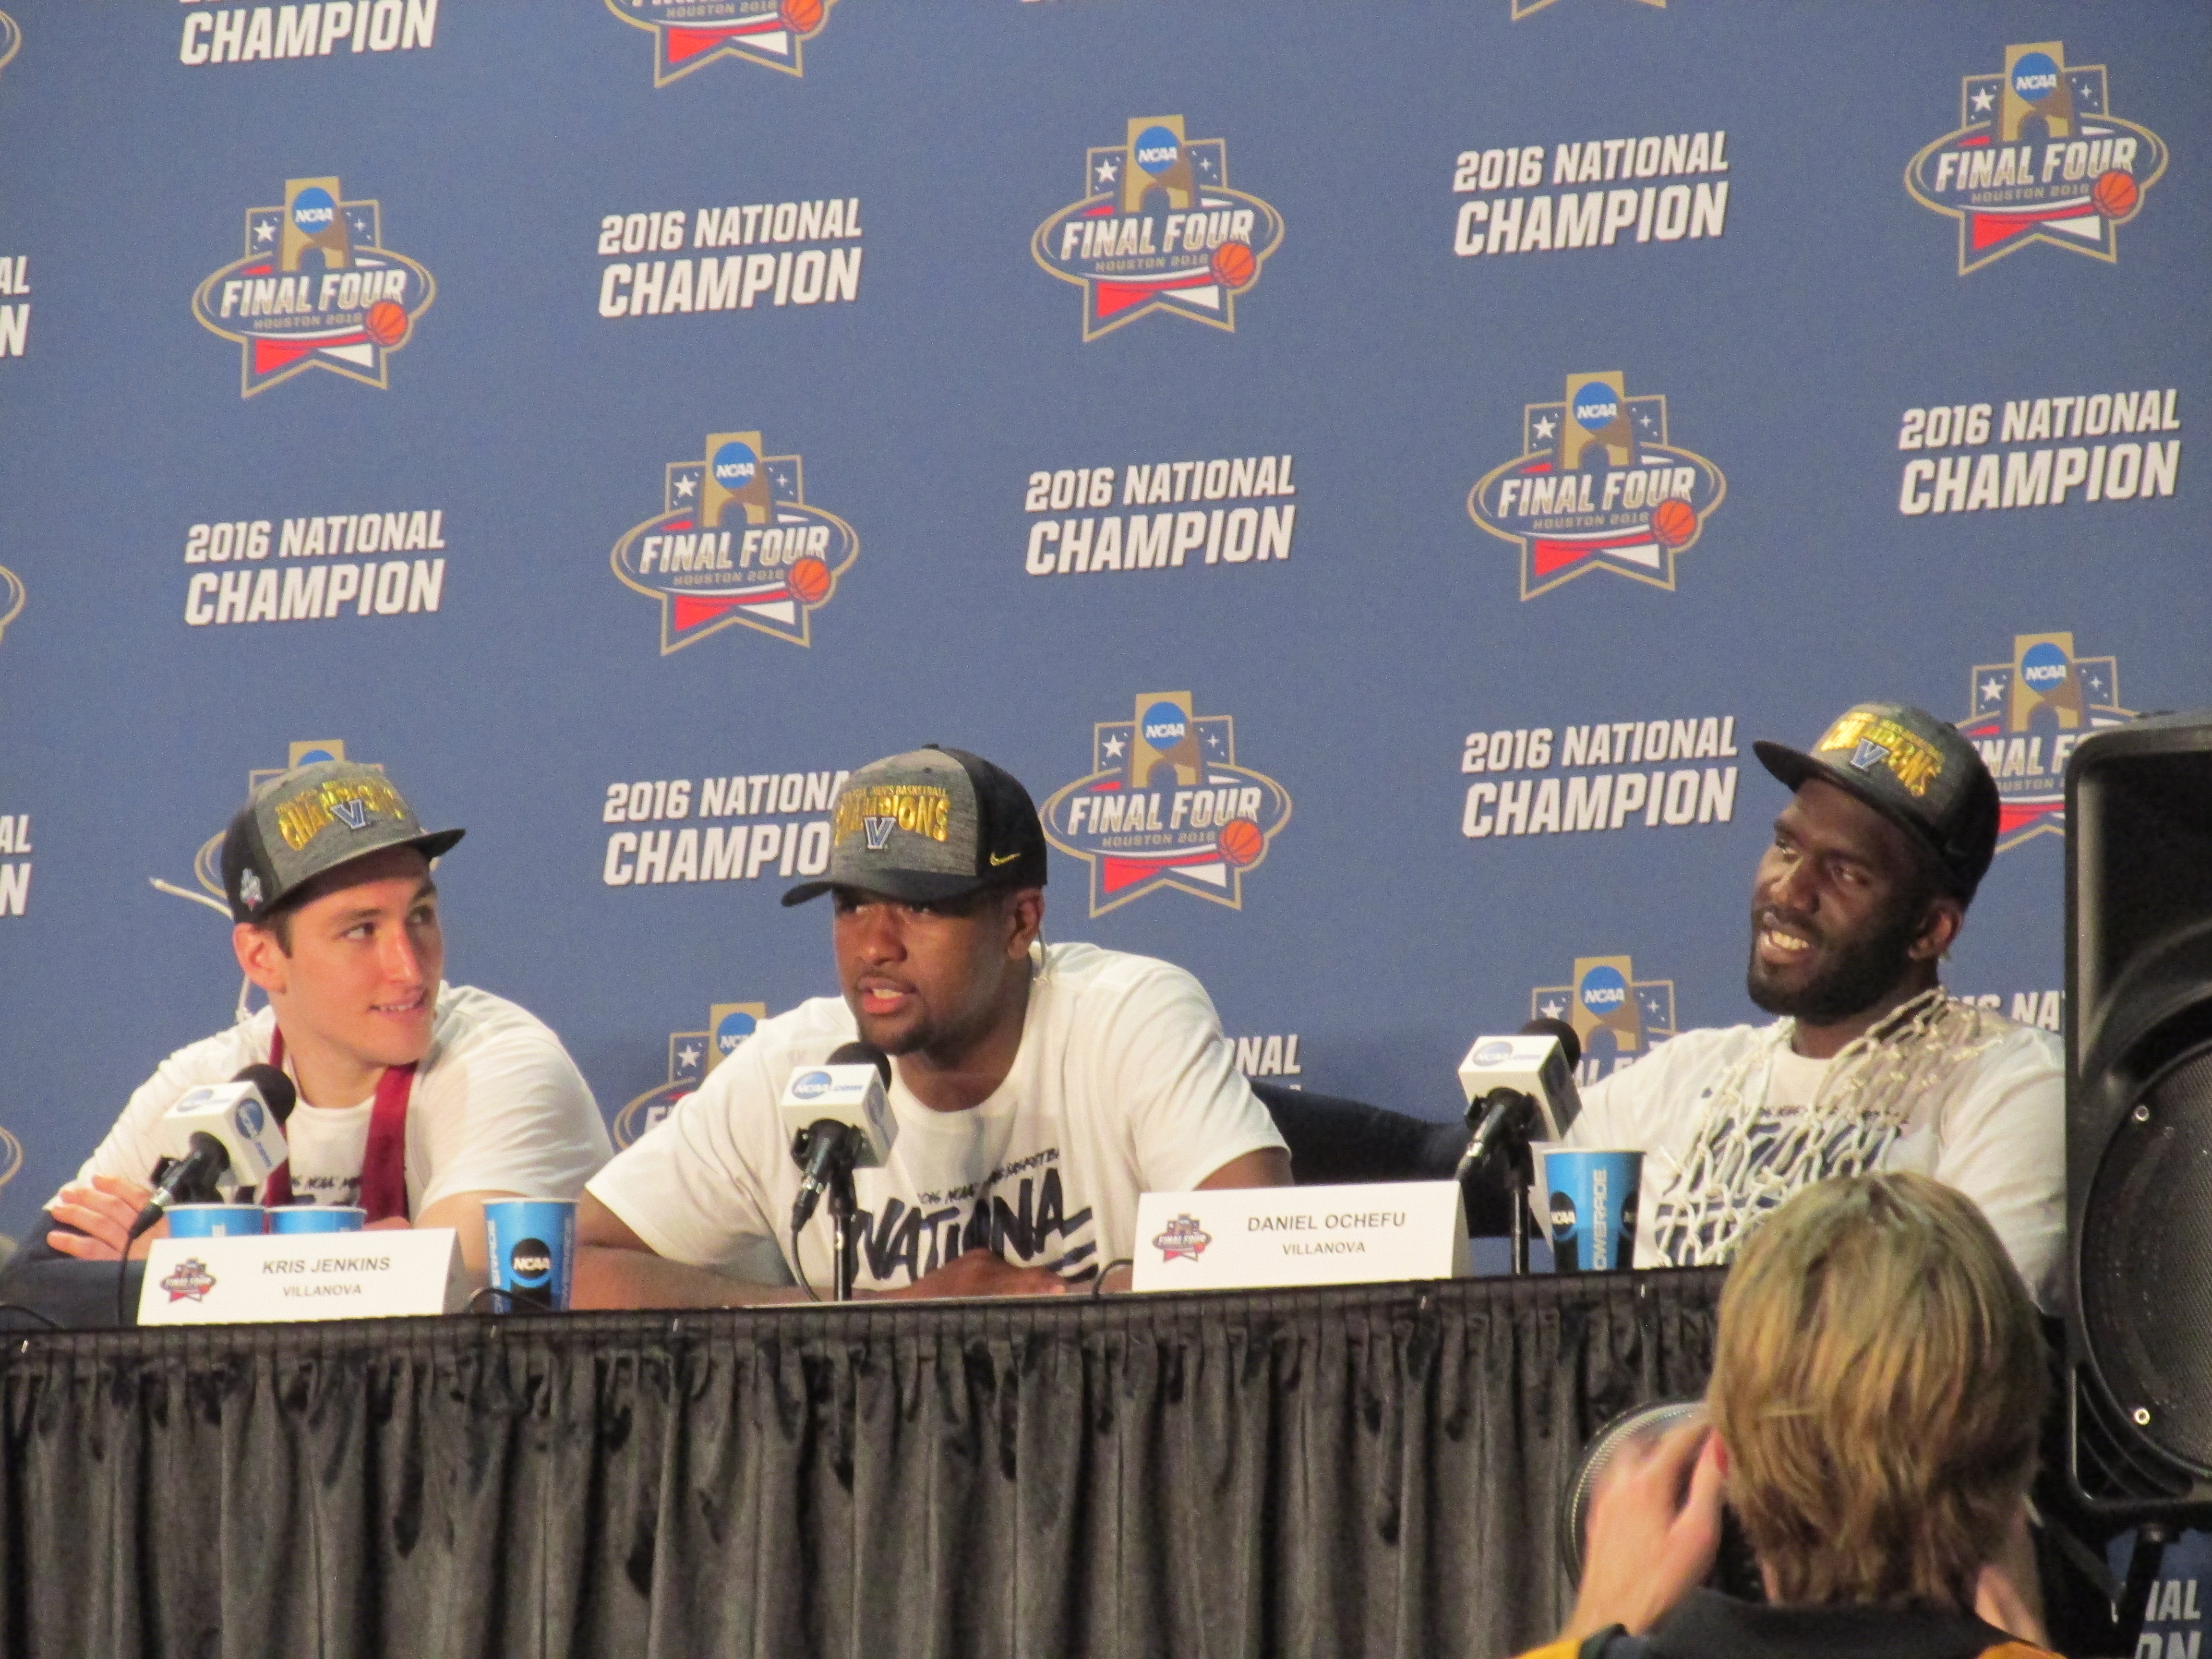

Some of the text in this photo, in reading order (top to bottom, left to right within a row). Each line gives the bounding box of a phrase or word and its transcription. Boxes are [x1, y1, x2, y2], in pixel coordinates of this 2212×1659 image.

[180, 0, 437, 64] CHAMPION
[666, 3, 735, 18] HOUSTON
[2016, 74, 2057, 90] NCAA
[1138, 146, 1177, 162] NCAA
[1454, 132, 1727, 192] 2016 NATIONAL
[1936, 137, 2138, 191] FINAL FOUR
[295, 209, 333, 222] NCAA
[1972, 188, 2044, 202] HOUSTON
[599, 198, 861, 255] 2016 NATIONAL
[1061, 209, 1255, 260] FINAL FOUR
[1455, 182, 1728, 256] CHAMPION
[599, 248, 861, 317] CHAMPION
[1096, 258, 1165, 272] HOUSTON
[221, 269, 407, 317] FINAL FOUR
[255, 316, 321, 328] HOUSTON
[1576, 403, 1618, 419] NCAA
[1899, 389, 2179, 450] 2016 NATIONAL
[716, 463, 755, 479] NCAA
[1025, 456, 1294, 511] 2016 NATIONAL
[1498, 467, 1696, 517] FINAL FOUR
[1899, 441, 2179, 515] CHAMPION
[185, 510, 444, 563] 2016 NATIONAL
[1026, 505, 1294, 575] CHAMPION
[1534, 517, 1605, 529] HOUSTON
[640, 526, 830, 573] FINAL FOUR
[185, 559, 445, 625] CHAMPION
[675, 573, 742, 585] HOUSTON
[2026, 666, 2067, 681] NCAA
[1145, 724, 1185, 738] NCAA
[1462, 716, 1736, 772] 2016 NATIONAL
[603, 780, 691, 822] 2016
[1068, 787, 1262, 834] FINAL FOUR
[1462, 767, 1736, 837] CHAMPION
[604, 821, 831, 886] CHAMPIO
[1103, 834, 1172, 847] HOUSTON
[1584, 989, 1624, 1003] NCAA
[1248, 1213, 1405, 1231] DANIEL OCHEFU
[1592, 1168, 1608, 1270] OWERADE
[263, 1258, 389, 1274] KRIS JENKINS
[513, 1257, 551, 1271] NCAA
[1283, 1242, 1365, 1255] VILLANOVA
[284, 1285, 361, 1297] VILLANOVA
